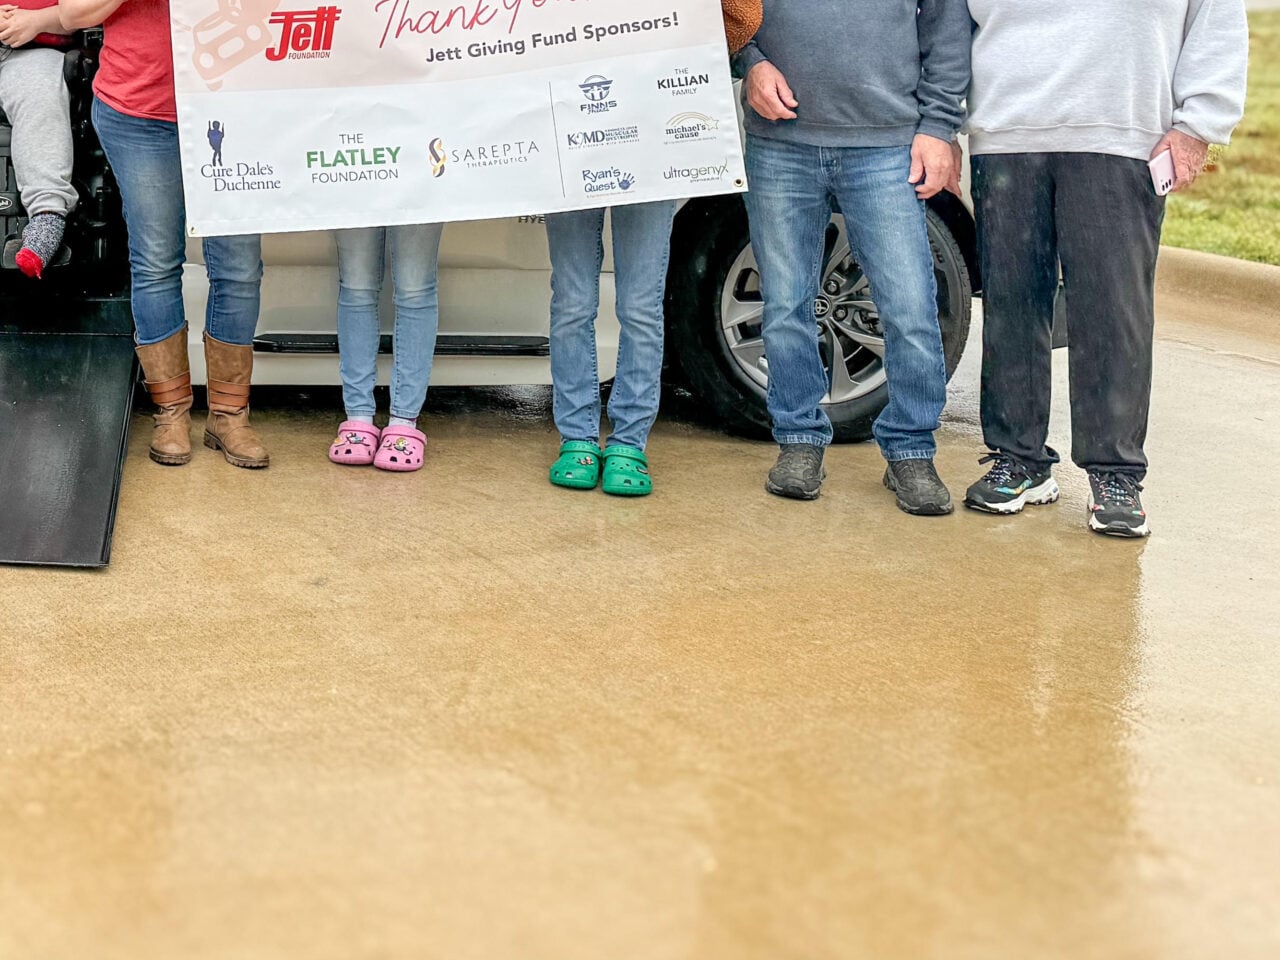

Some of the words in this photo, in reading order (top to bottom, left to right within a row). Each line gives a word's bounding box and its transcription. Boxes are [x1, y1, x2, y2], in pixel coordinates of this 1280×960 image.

[265, 6, 342, 61] Jett
[426, 48, 462, 63] Jett
[467, 40, 525, 57] Giving
[531, 26, 577, 48] Fund
[583, 11, 679, 42] Sponsors!
[287, 51, 332, 60] FOUNDATION
[673, 67, 689, 75] THE
[657, 73, 709, 90] KILLIAN
[671, 87, 698, 96] FAMILY
[665, 123, 707, 135] michael's
[674, 131, 699, 140] cause
[338, 132, 365, 145] THE
[306, 146, 401, 168] FLATLEY
[451, 141, 540, 163] SAREPTA
[201, 163, 233, 178] Cure
[236, 161, 274, 177] Dale's
[466, 156, 528, 169] THERAPEUTICS
[663, 156, 729, 181] ultragenyx
[311, 168, 399, 183] FOUNDATION
[582, 166, 621, 183] Ryan's
[214, 176, 282, 192] Duchenne
[584, 181, 617, 193] Quest
